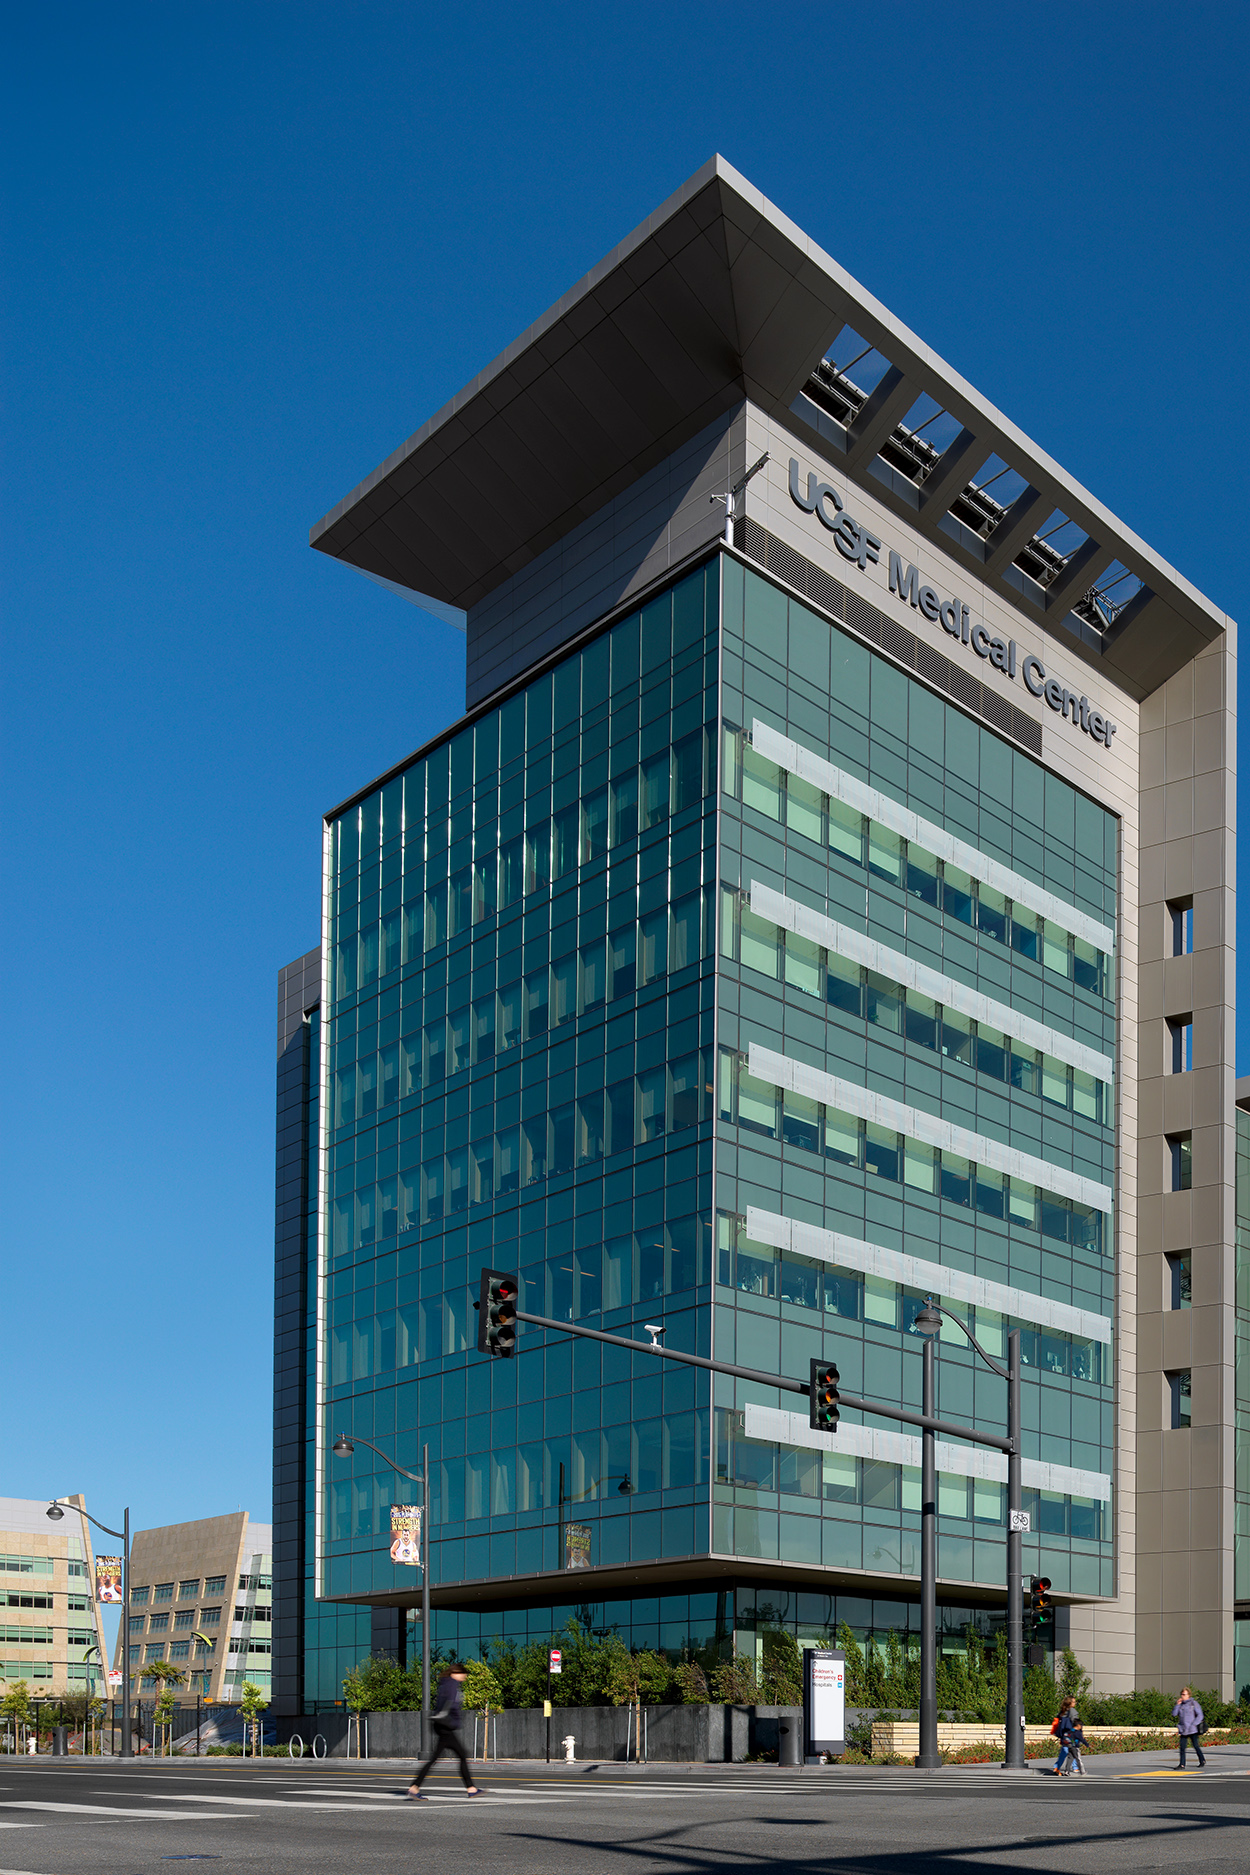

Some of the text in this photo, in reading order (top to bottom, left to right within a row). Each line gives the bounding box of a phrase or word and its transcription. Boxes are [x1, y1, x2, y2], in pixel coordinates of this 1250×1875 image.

[789, 457, 1117, 749] UCSF Medical Center
[391, 1517, 420, 1525] STRENGTH
